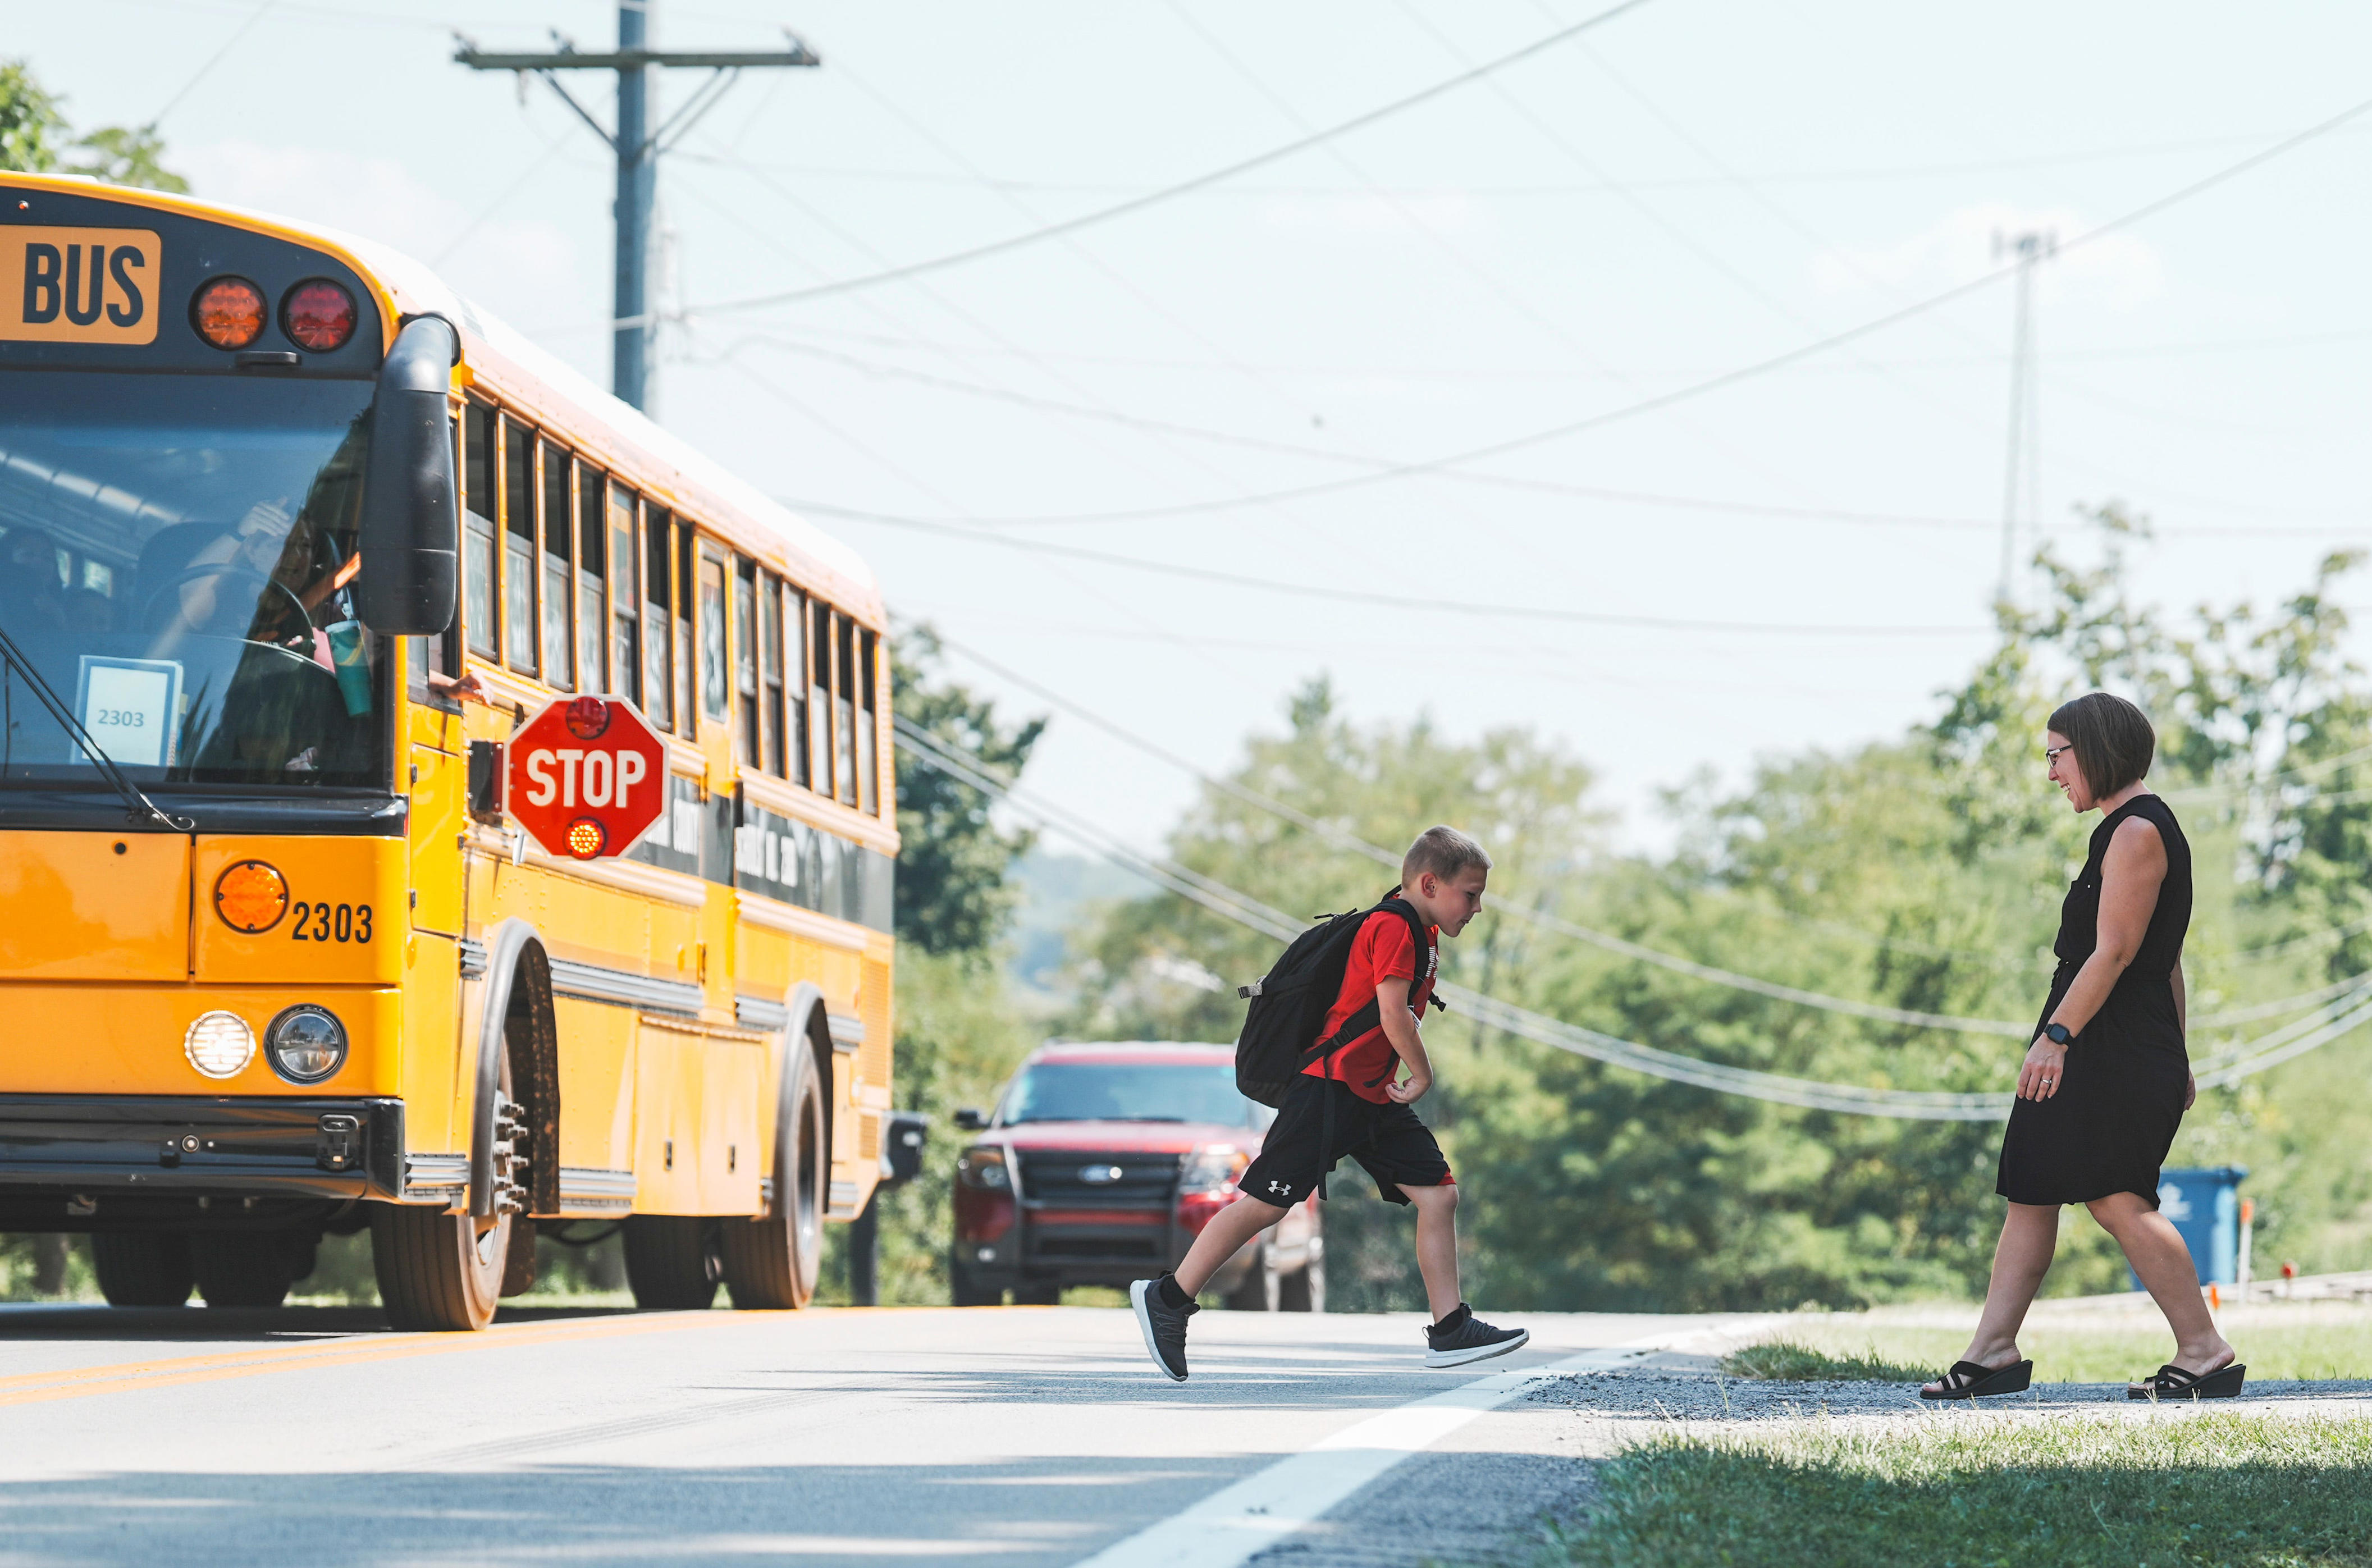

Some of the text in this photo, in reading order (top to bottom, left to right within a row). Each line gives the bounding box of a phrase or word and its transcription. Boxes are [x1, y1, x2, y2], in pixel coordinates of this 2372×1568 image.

[22, 243, 145, 327] BUS
[98, 709, 144, 727] 2303
[526, 748, 646, 808] STOP
[292, 902, 372, 943] 2303
